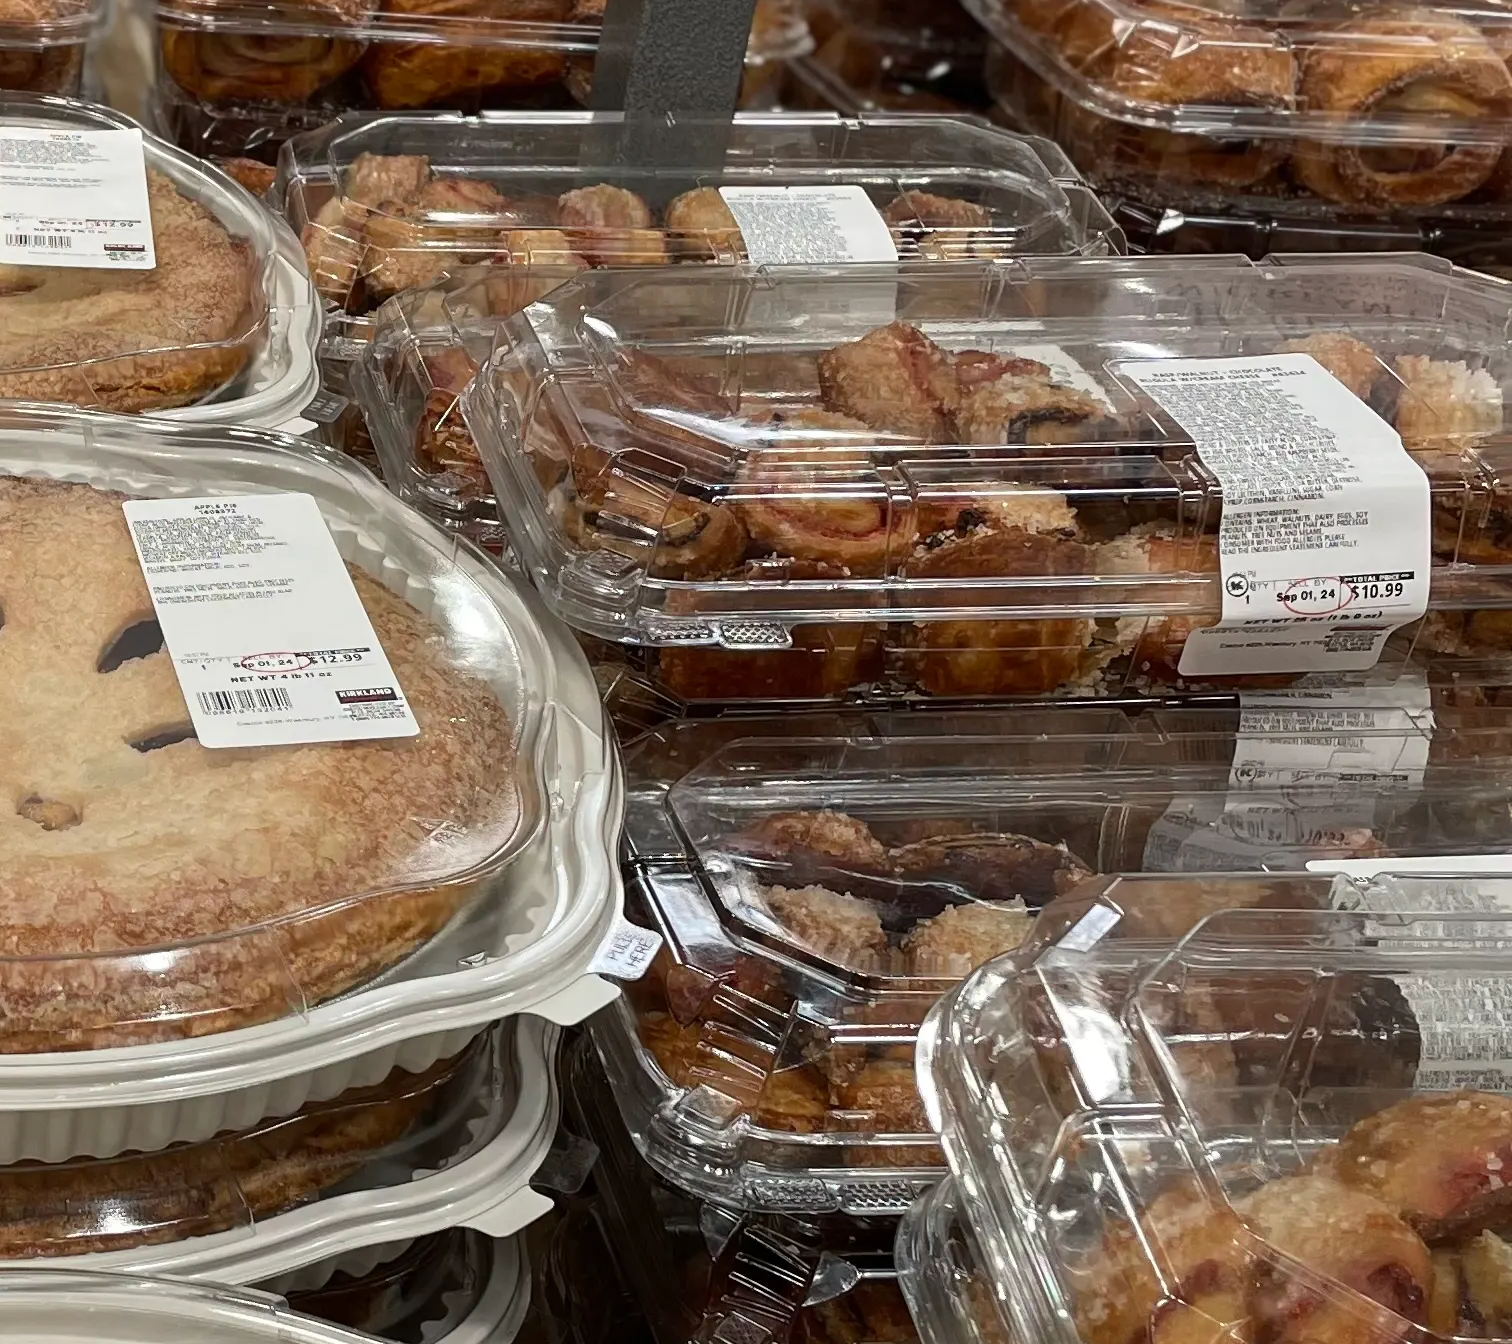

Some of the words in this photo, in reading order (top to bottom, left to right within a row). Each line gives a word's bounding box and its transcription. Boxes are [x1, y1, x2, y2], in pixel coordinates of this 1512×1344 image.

[1276, 592, 1297, 603] Sep
[1300, 590, 1317, 602] 01,
[1320, 589, 1336, 599] 24
[1352, 582, 1403, 601] $10.99
[338, 688, 392, 698] KIRKLAND
